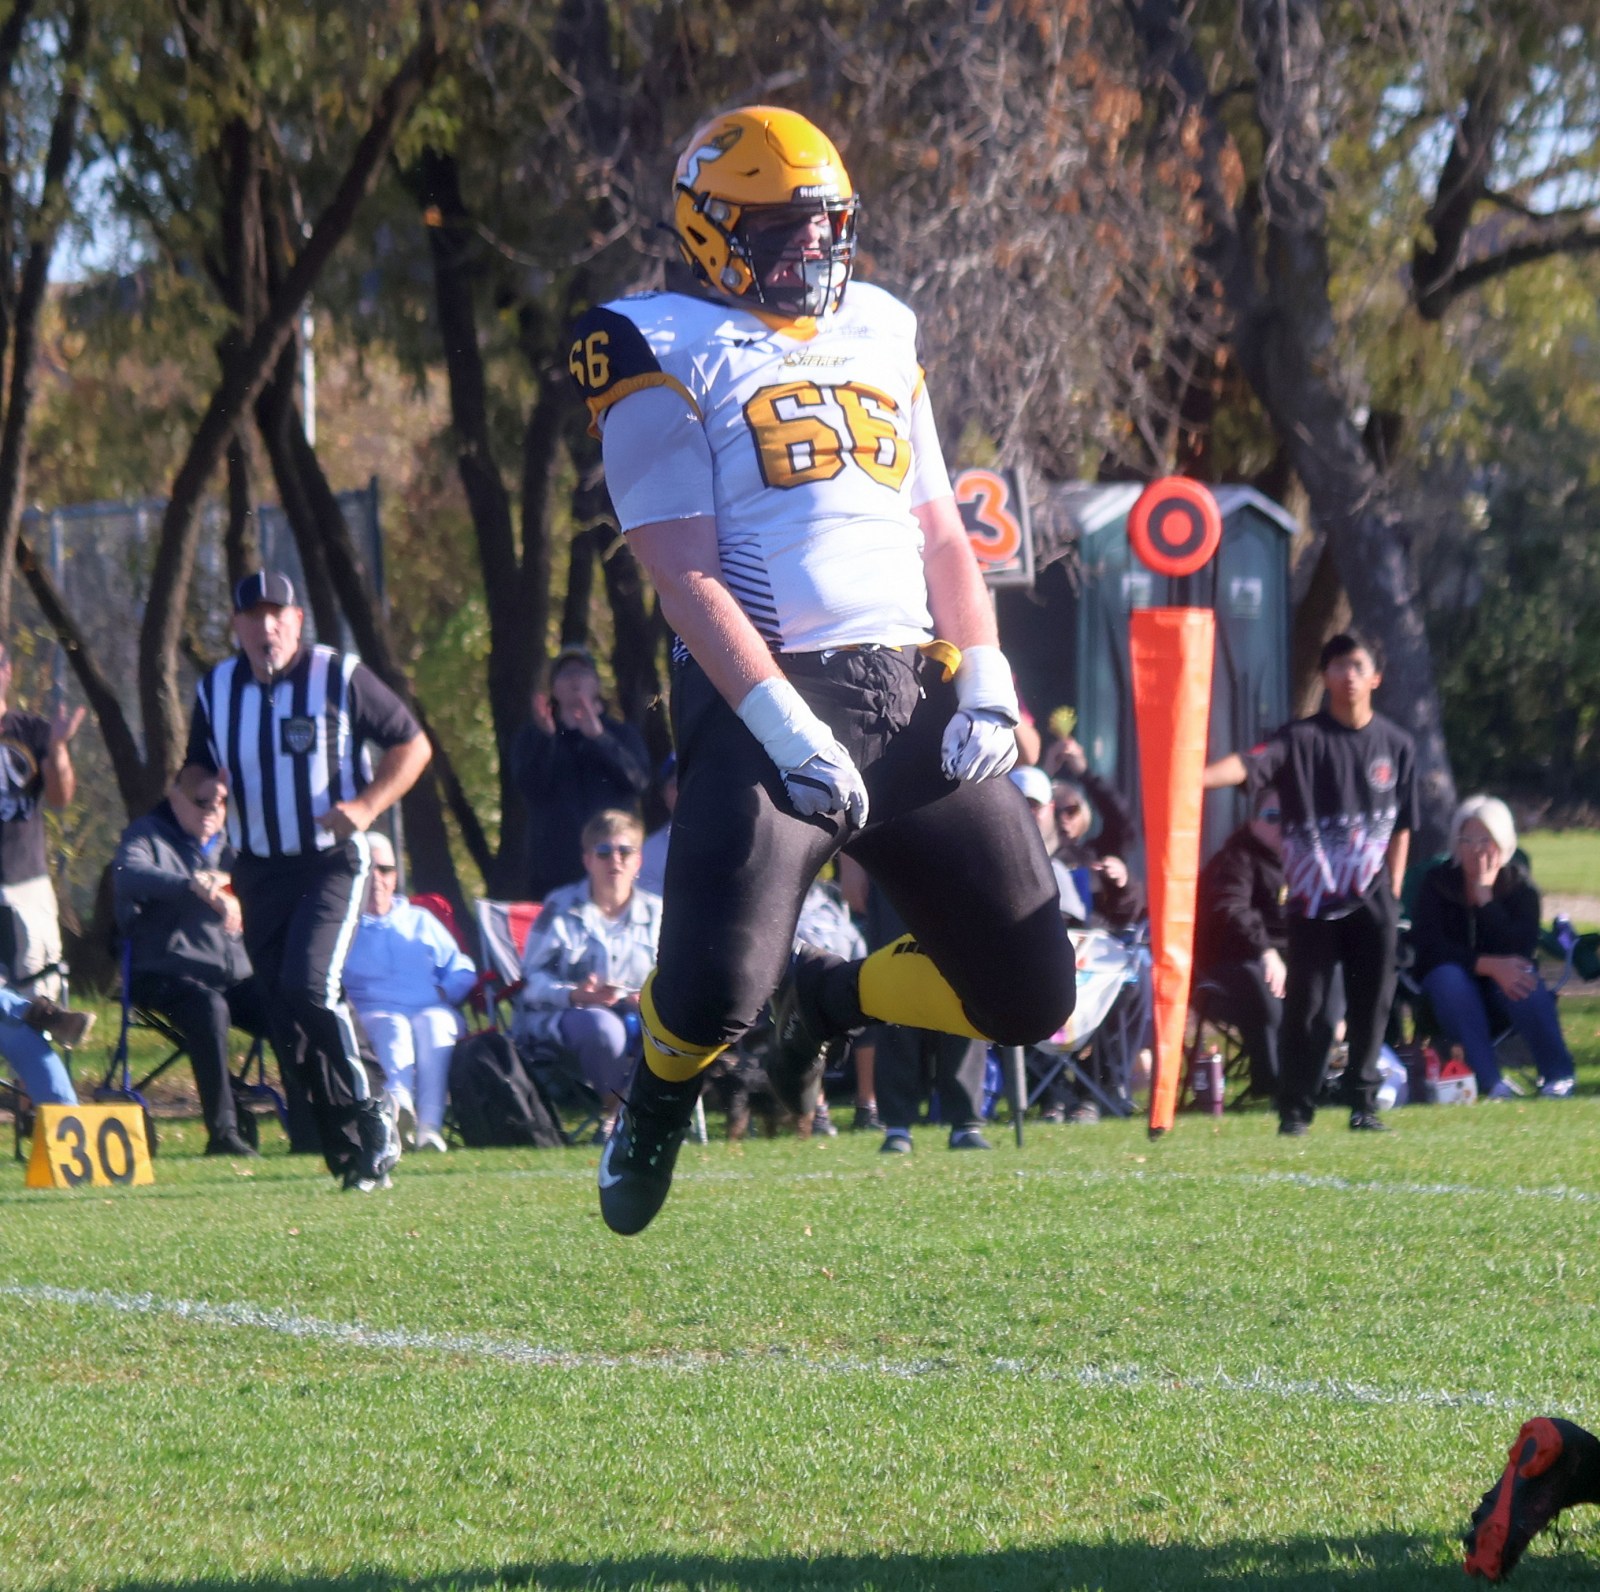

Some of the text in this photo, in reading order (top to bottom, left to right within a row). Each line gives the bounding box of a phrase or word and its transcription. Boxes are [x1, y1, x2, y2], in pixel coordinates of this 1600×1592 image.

[742, 380, 912, 493] 66
[954, 469, 1021, 563] 3
[56, 1115, 135, 1187] 30
